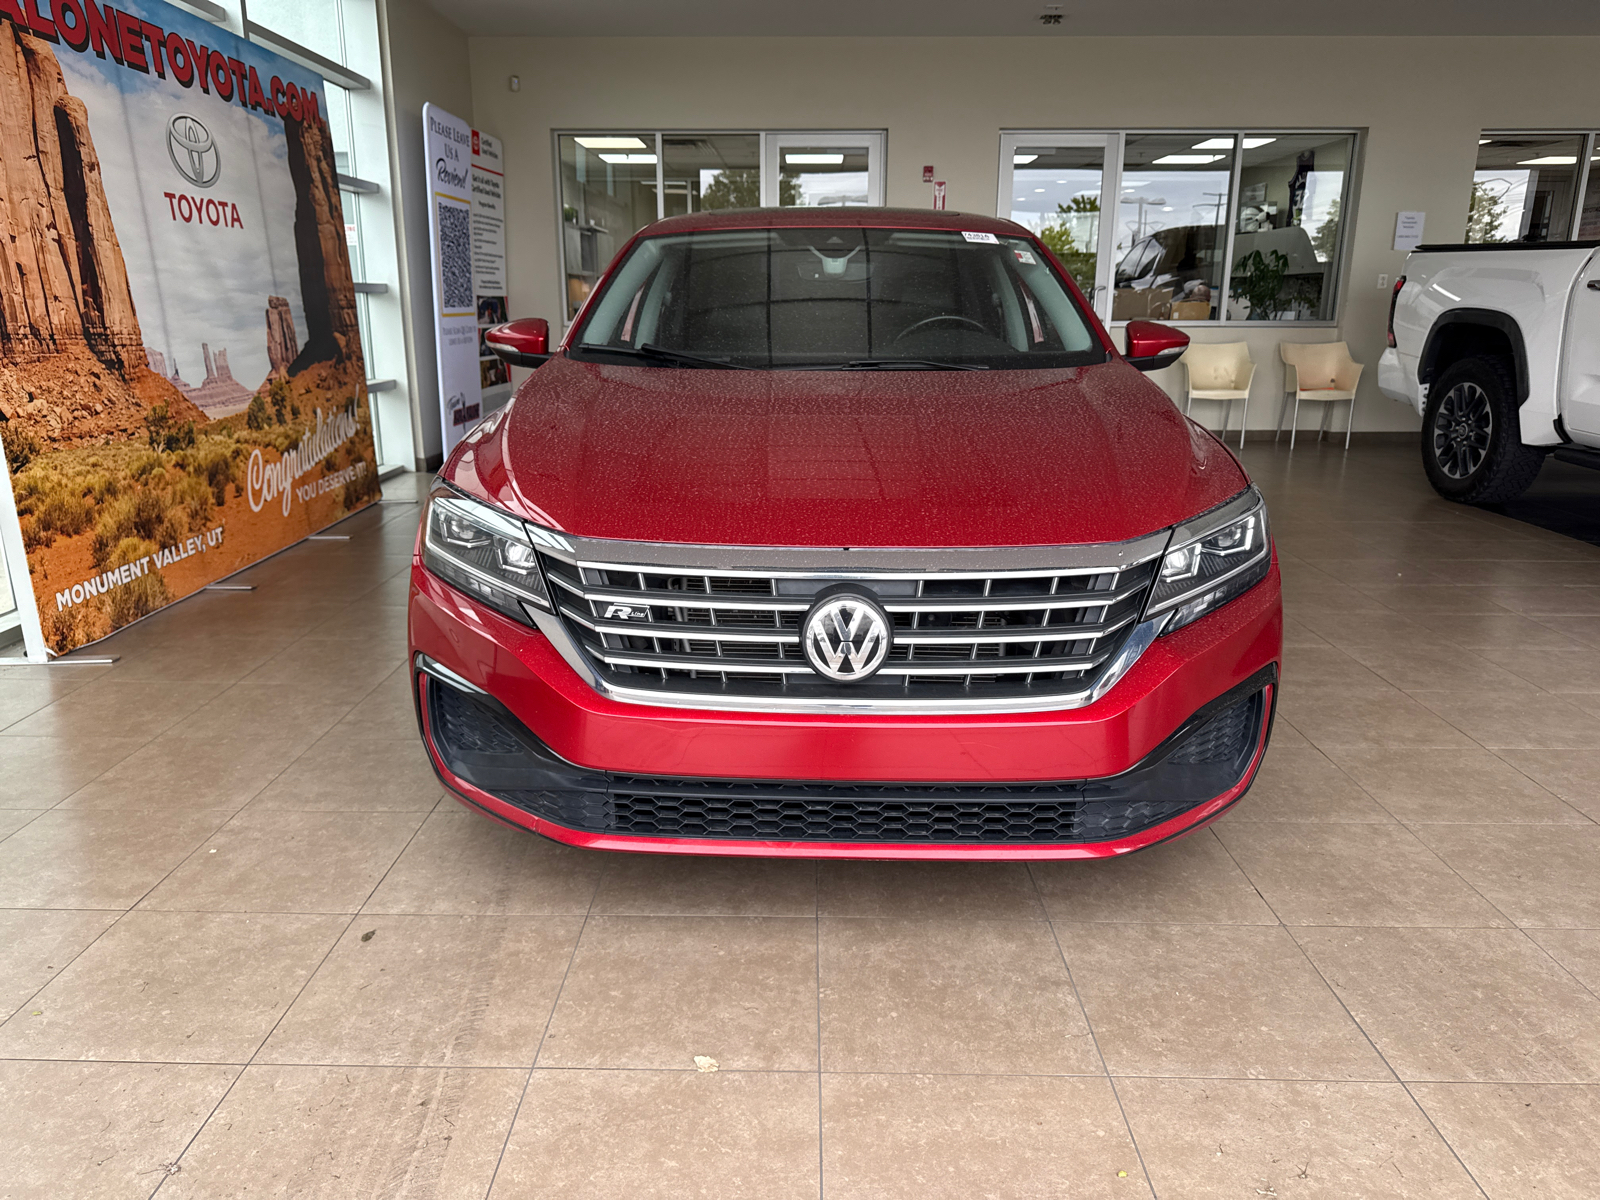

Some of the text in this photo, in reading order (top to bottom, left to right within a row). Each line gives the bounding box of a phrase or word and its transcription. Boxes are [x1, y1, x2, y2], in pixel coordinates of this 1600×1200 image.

[0, 0, 322, 128] LONETOYOTA.COM
[430, 116, 452, 140] PLEASE
[453, 127, 470, 148] LEAVE
[163, 191, 245, 230] TOYOTA
[247, 383, 361, 517] Congratulations!
[296, 482, 317, 503] YOU
[319, 465, 356, 495] DESERVE
[55, 527, 223, 612] MONUMENT VALLEY, UT
